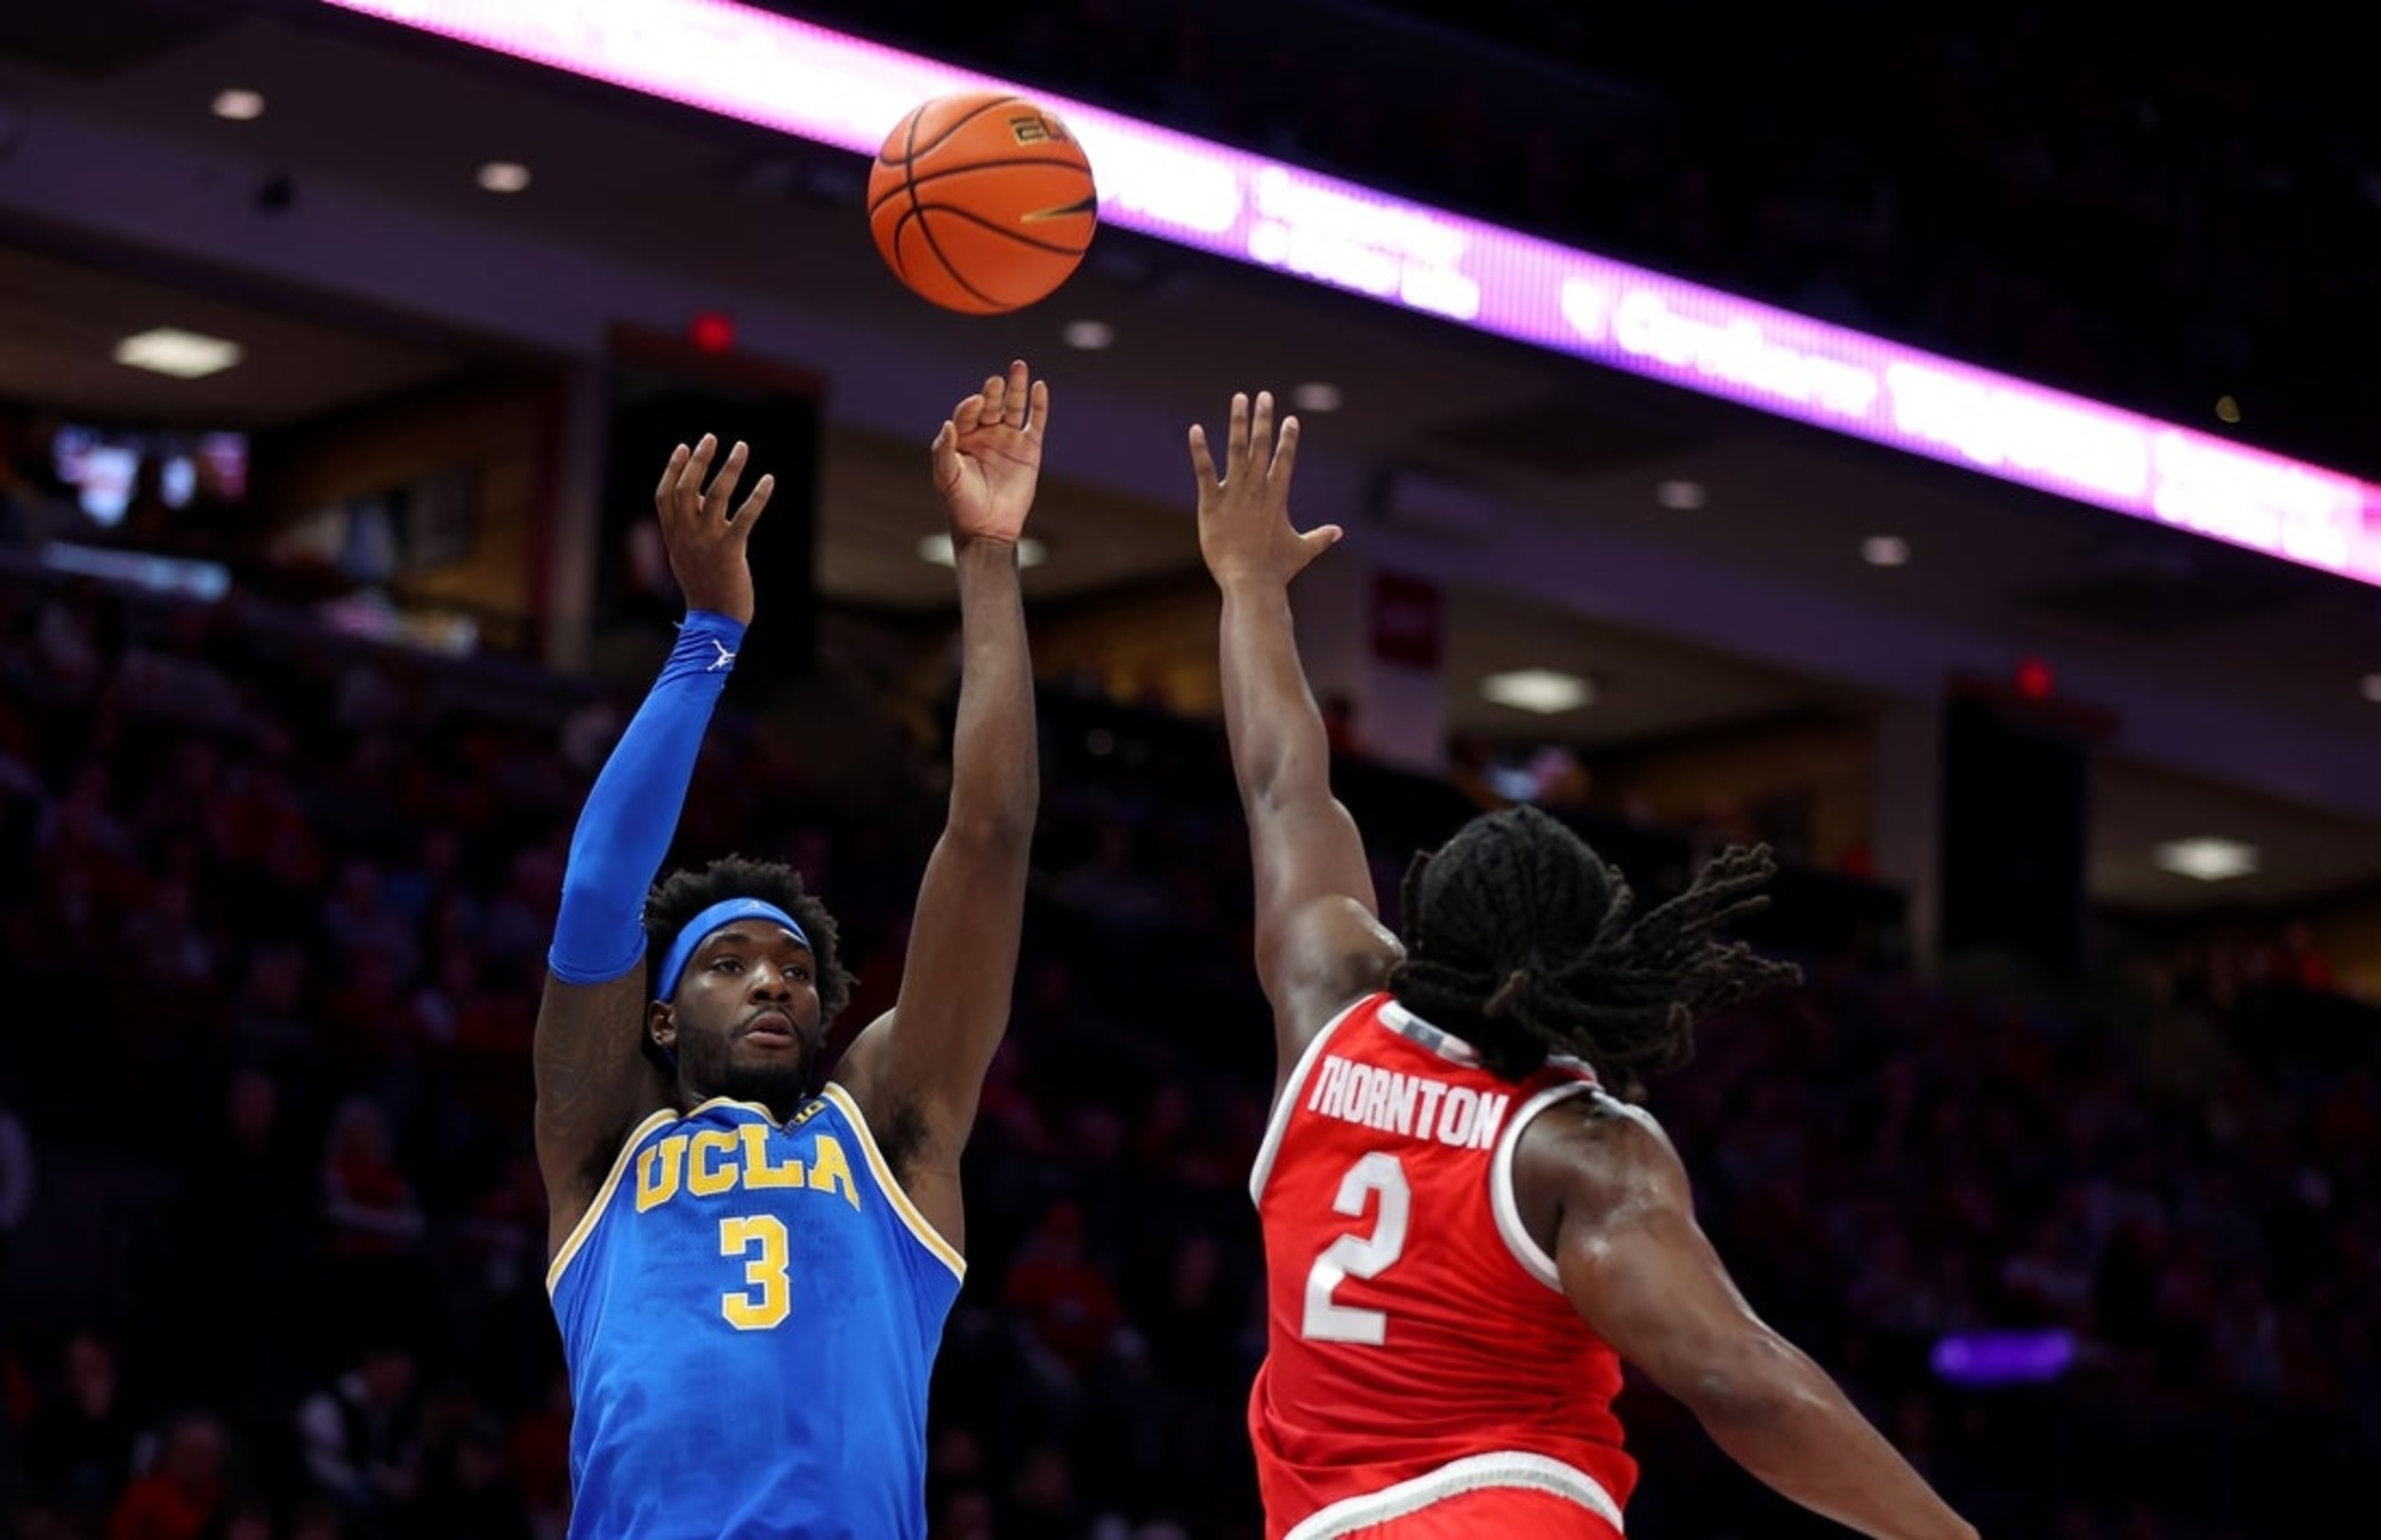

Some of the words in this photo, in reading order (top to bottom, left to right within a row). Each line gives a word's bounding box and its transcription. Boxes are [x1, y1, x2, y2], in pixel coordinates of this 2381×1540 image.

[1307, 1054, 1510, 1150] THORNTON
[634, 1123, 861, 1214] UCLA
[718, 1213, 791, 1331] 3
[1301, 1150, 1411, 1347] 2
